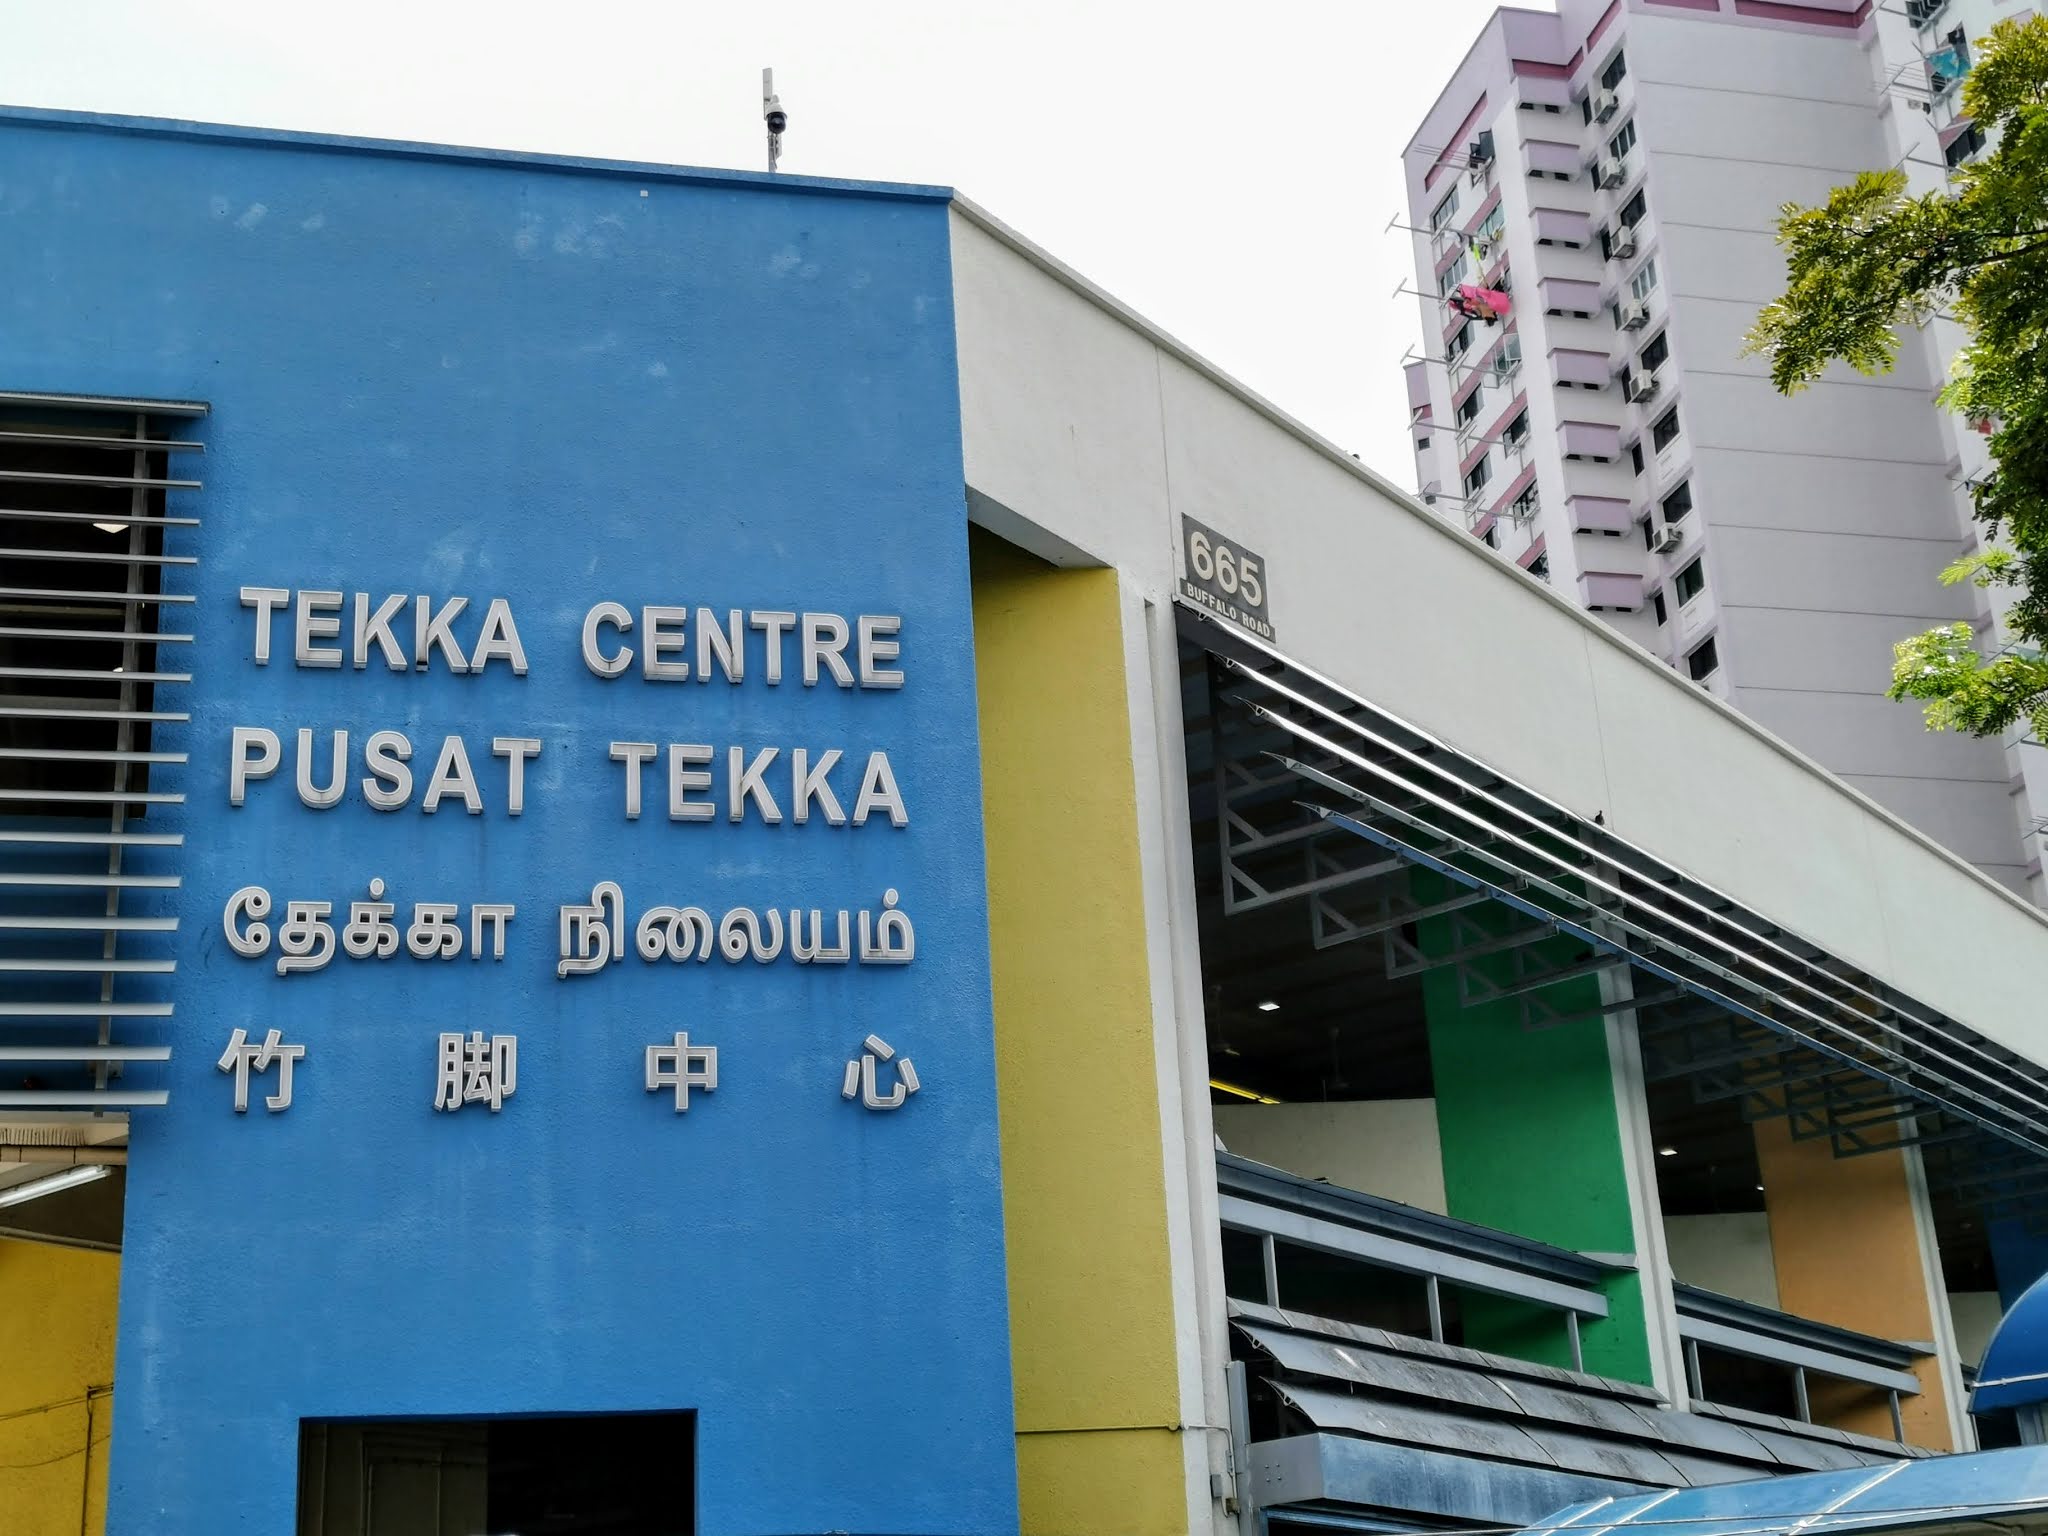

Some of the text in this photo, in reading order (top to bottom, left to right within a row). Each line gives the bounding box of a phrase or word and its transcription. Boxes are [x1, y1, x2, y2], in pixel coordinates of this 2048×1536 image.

[1187, 582, 1271, 638] BUFFALO ROAD
[1190, 531, 1262, 607] 665
[240, 586, 905, 689] TEKKA CENTRE
[230, 727, 909, 828] PUSAT TEKKA
[223, 878, 915, 979] தேக்கா நிலையம்
[217, 1028, 921, 1113] 竹脚中心
